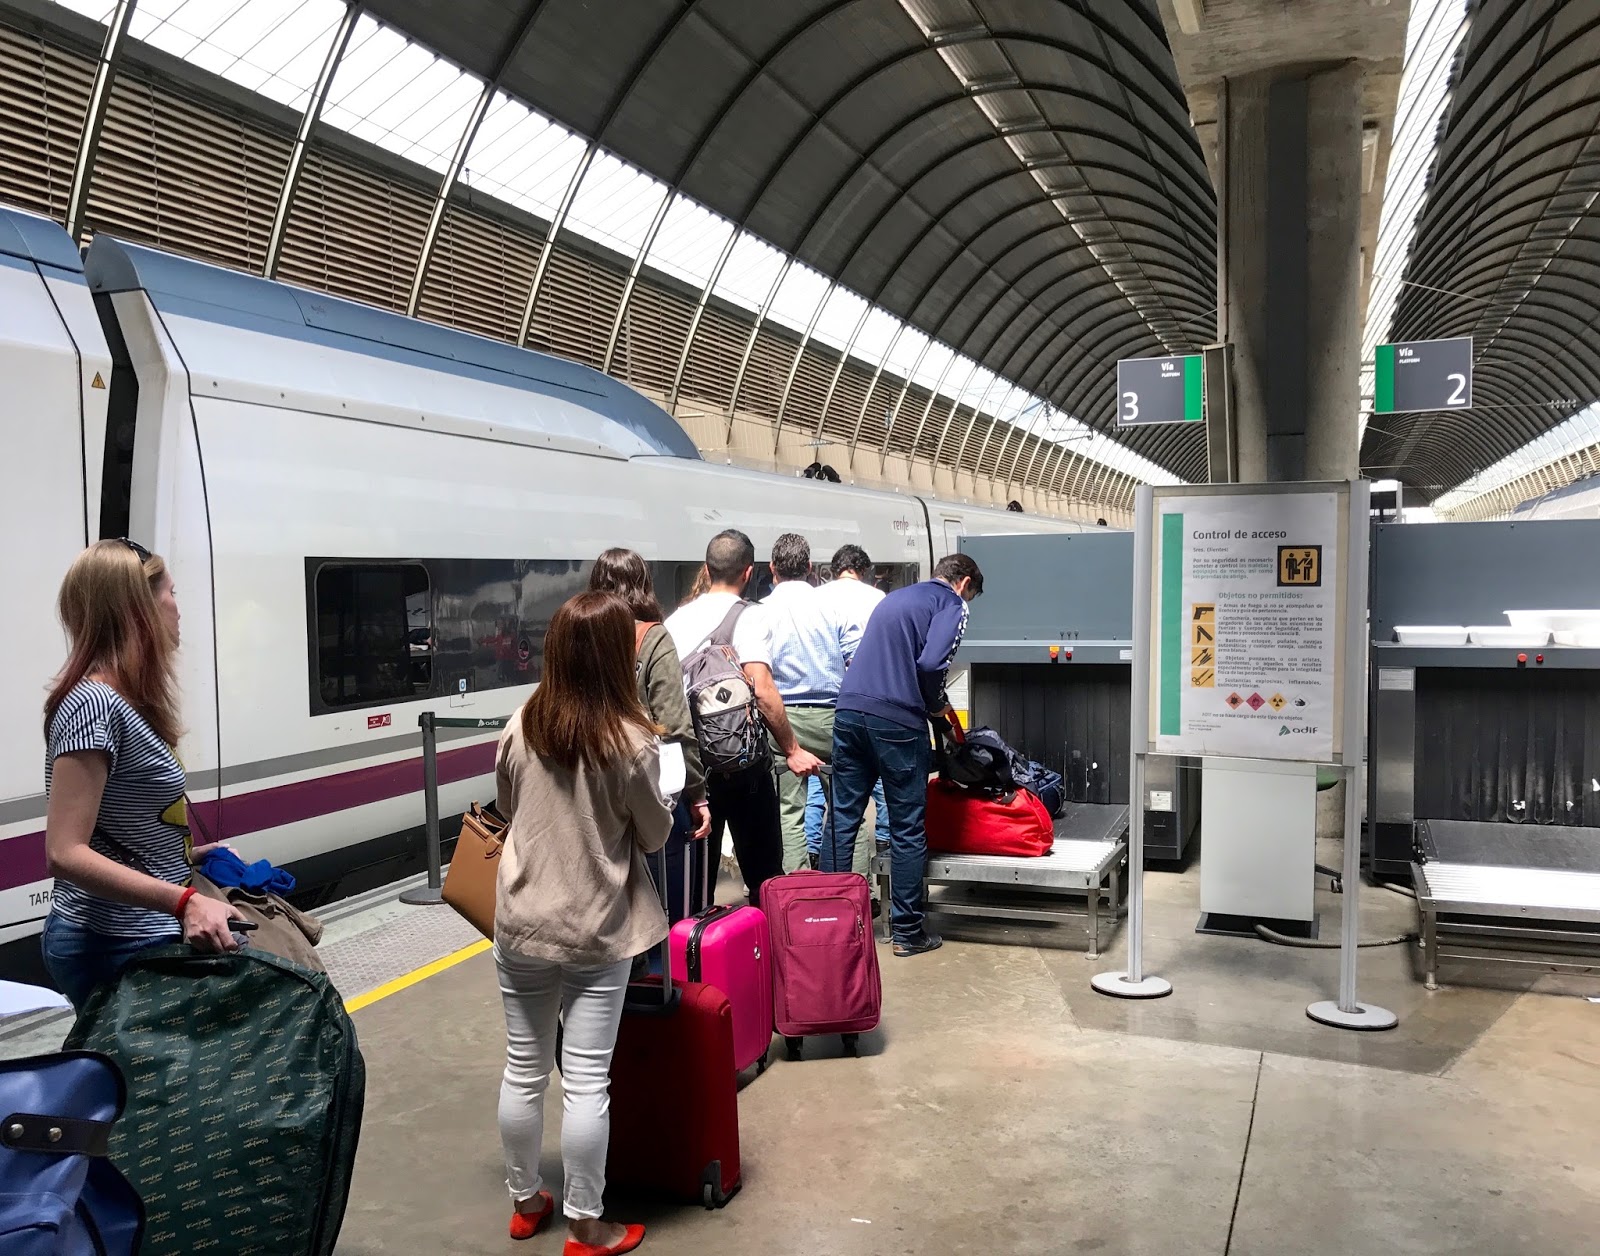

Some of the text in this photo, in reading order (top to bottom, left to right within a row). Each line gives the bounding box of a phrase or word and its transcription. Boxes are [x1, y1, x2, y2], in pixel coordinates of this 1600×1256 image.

[1399, 348, 1413, 356] Vía
[1161, 362, 1174, 371] Vía
[1447, 373, 1466, 405] 2
[1123, 392, 1138, 420] 3
[1193, 530, 1287, 539] Control de acceso
